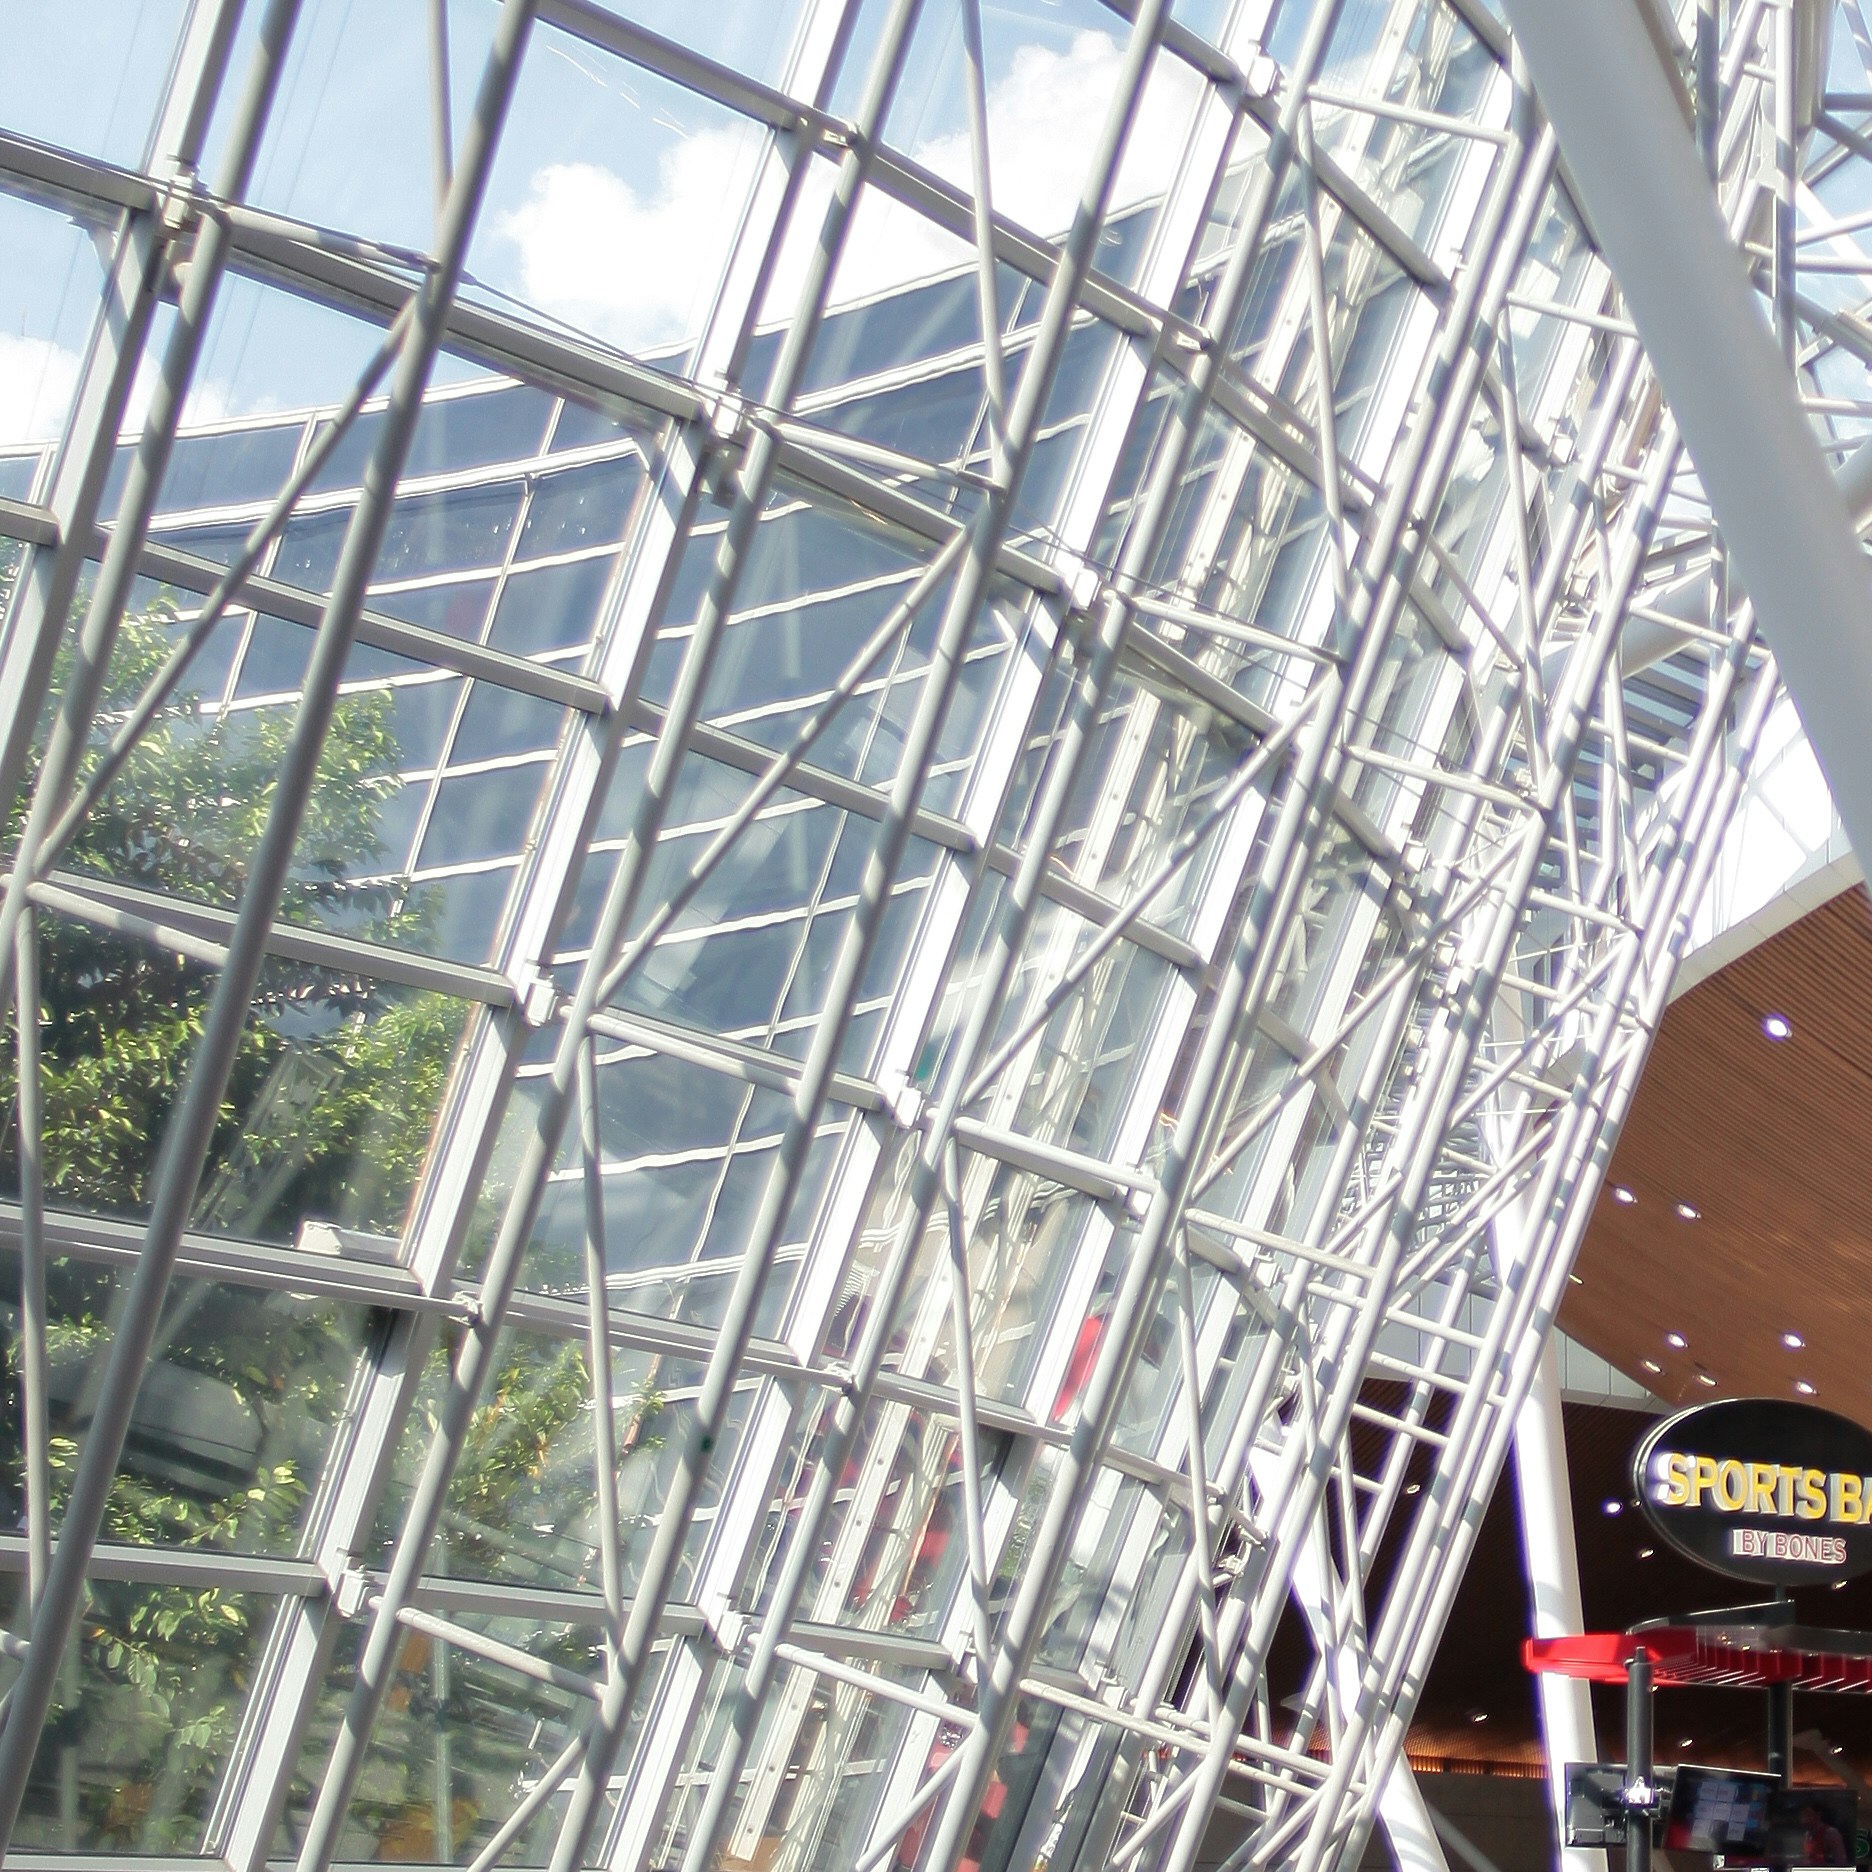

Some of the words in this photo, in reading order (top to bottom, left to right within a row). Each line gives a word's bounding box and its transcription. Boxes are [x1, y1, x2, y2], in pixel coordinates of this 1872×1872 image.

[1658, 1451, 1827, 1519] SPORTS
[1733, 1528, 1766, 1556] BY
[1766, 1530, 1847, 1564] BONES
